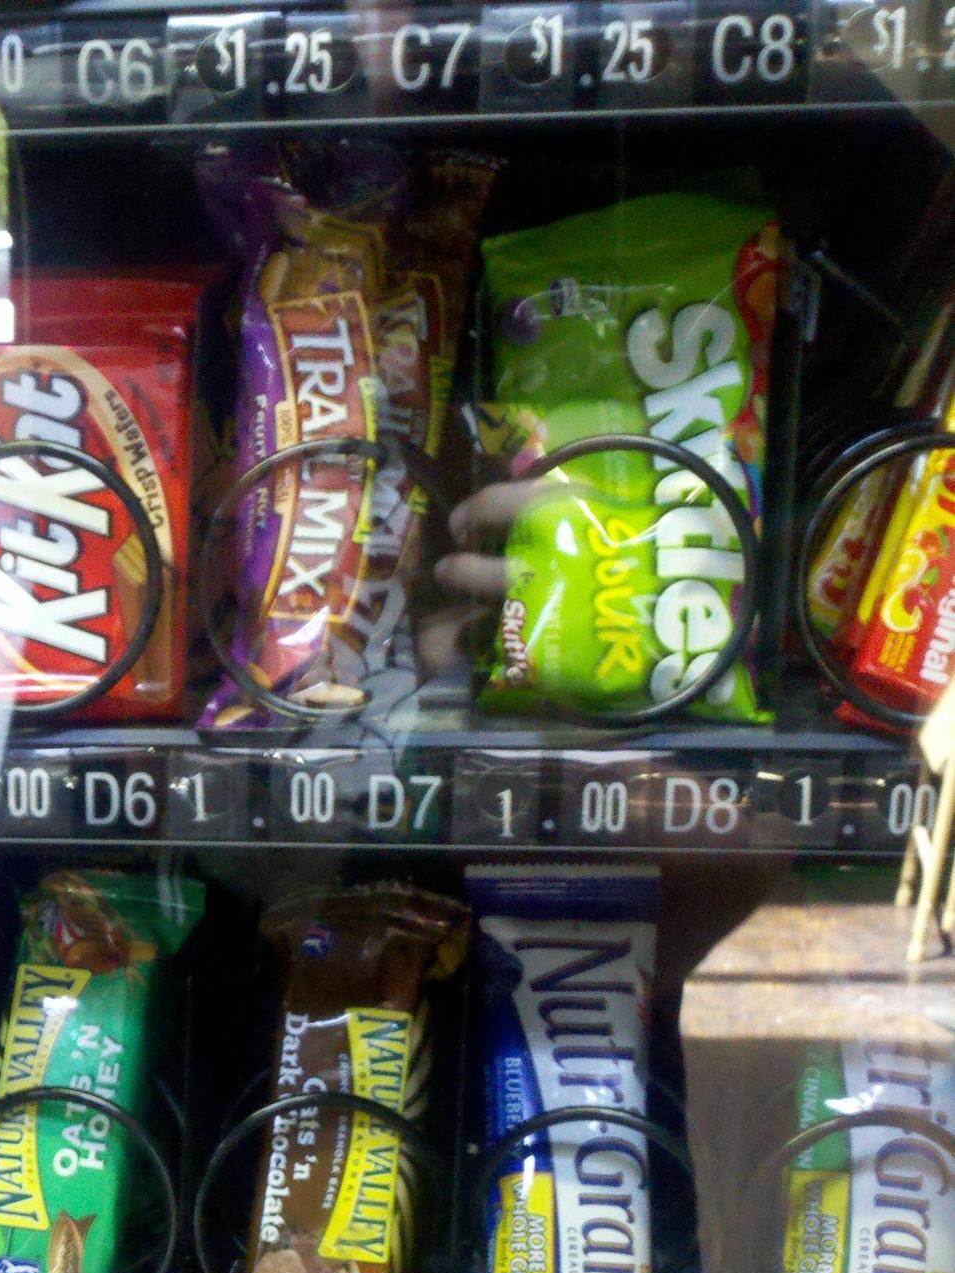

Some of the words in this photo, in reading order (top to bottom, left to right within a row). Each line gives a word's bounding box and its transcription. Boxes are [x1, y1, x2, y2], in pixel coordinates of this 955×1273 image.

[76, 38, 157, 103] C6
[390, 22, 472, 91] C7
[711, 14, 794, 84] C8
[289, 318, 356, 484] TRAL
[276, 489, 350, 597] MIX
[83, 771, 157, 828] D6
[367, 774, 443, 831] D7
[662, 778, 741, 836] D8
[277, 1011, 309, 1086] Dark
[356, 1014, 410, 1137] NATUE
[334, 1145, 395, 1258] VALLEY
[528, 1214, 548, 1273] MORE
